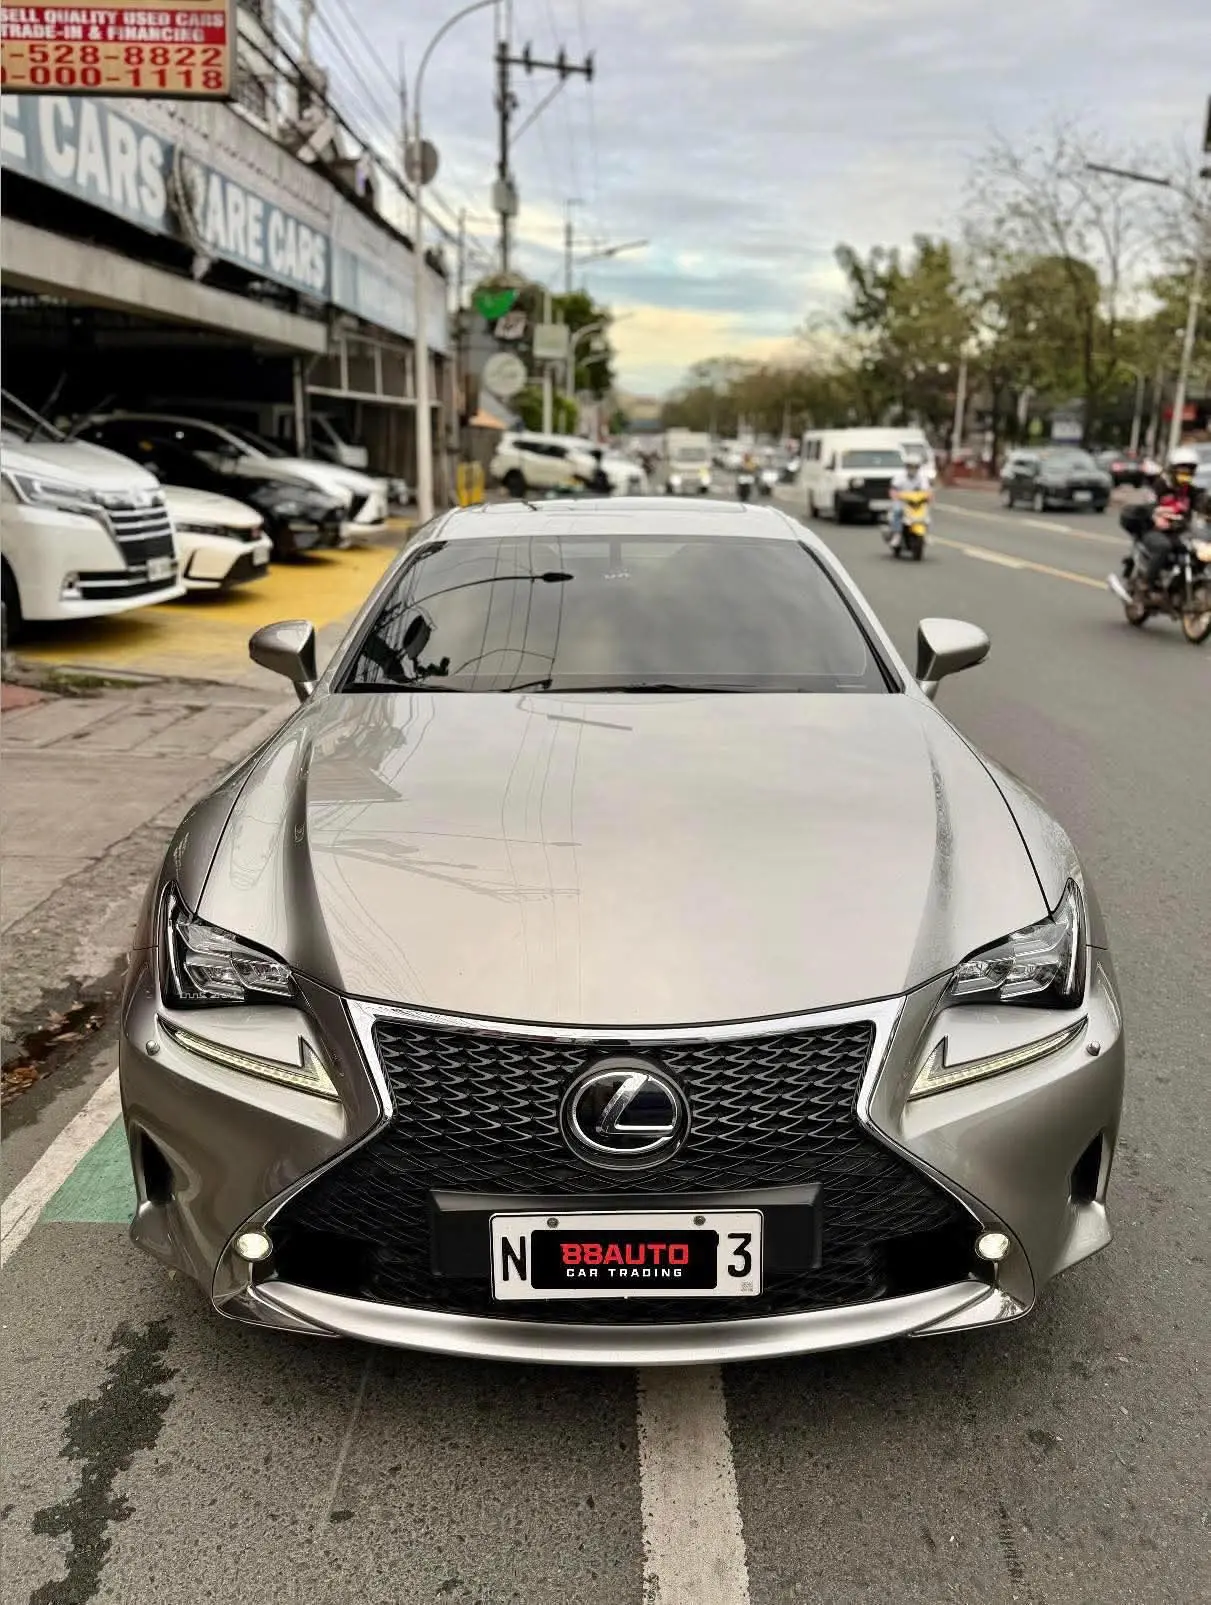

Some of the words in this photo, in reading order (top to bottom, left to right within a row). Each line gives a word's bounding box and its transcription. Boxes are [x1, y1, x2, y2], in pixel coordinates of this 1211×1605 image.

[1, 7, 39, 23] SELL
[44, 8, 117, 25] QUALITY
[123, 11, 170, 26] USED
[175, 13, 224, 28] CARS
[1, 24, 83, 40] TRADE-IN
[88, 26, 102, 40] &
[107, 26, 204, 42] FINANCING
[1, 44, 223, 67] -528-8822
[38, 96, 166, 218] CARS
[267, 209, 326, 292] CARS
